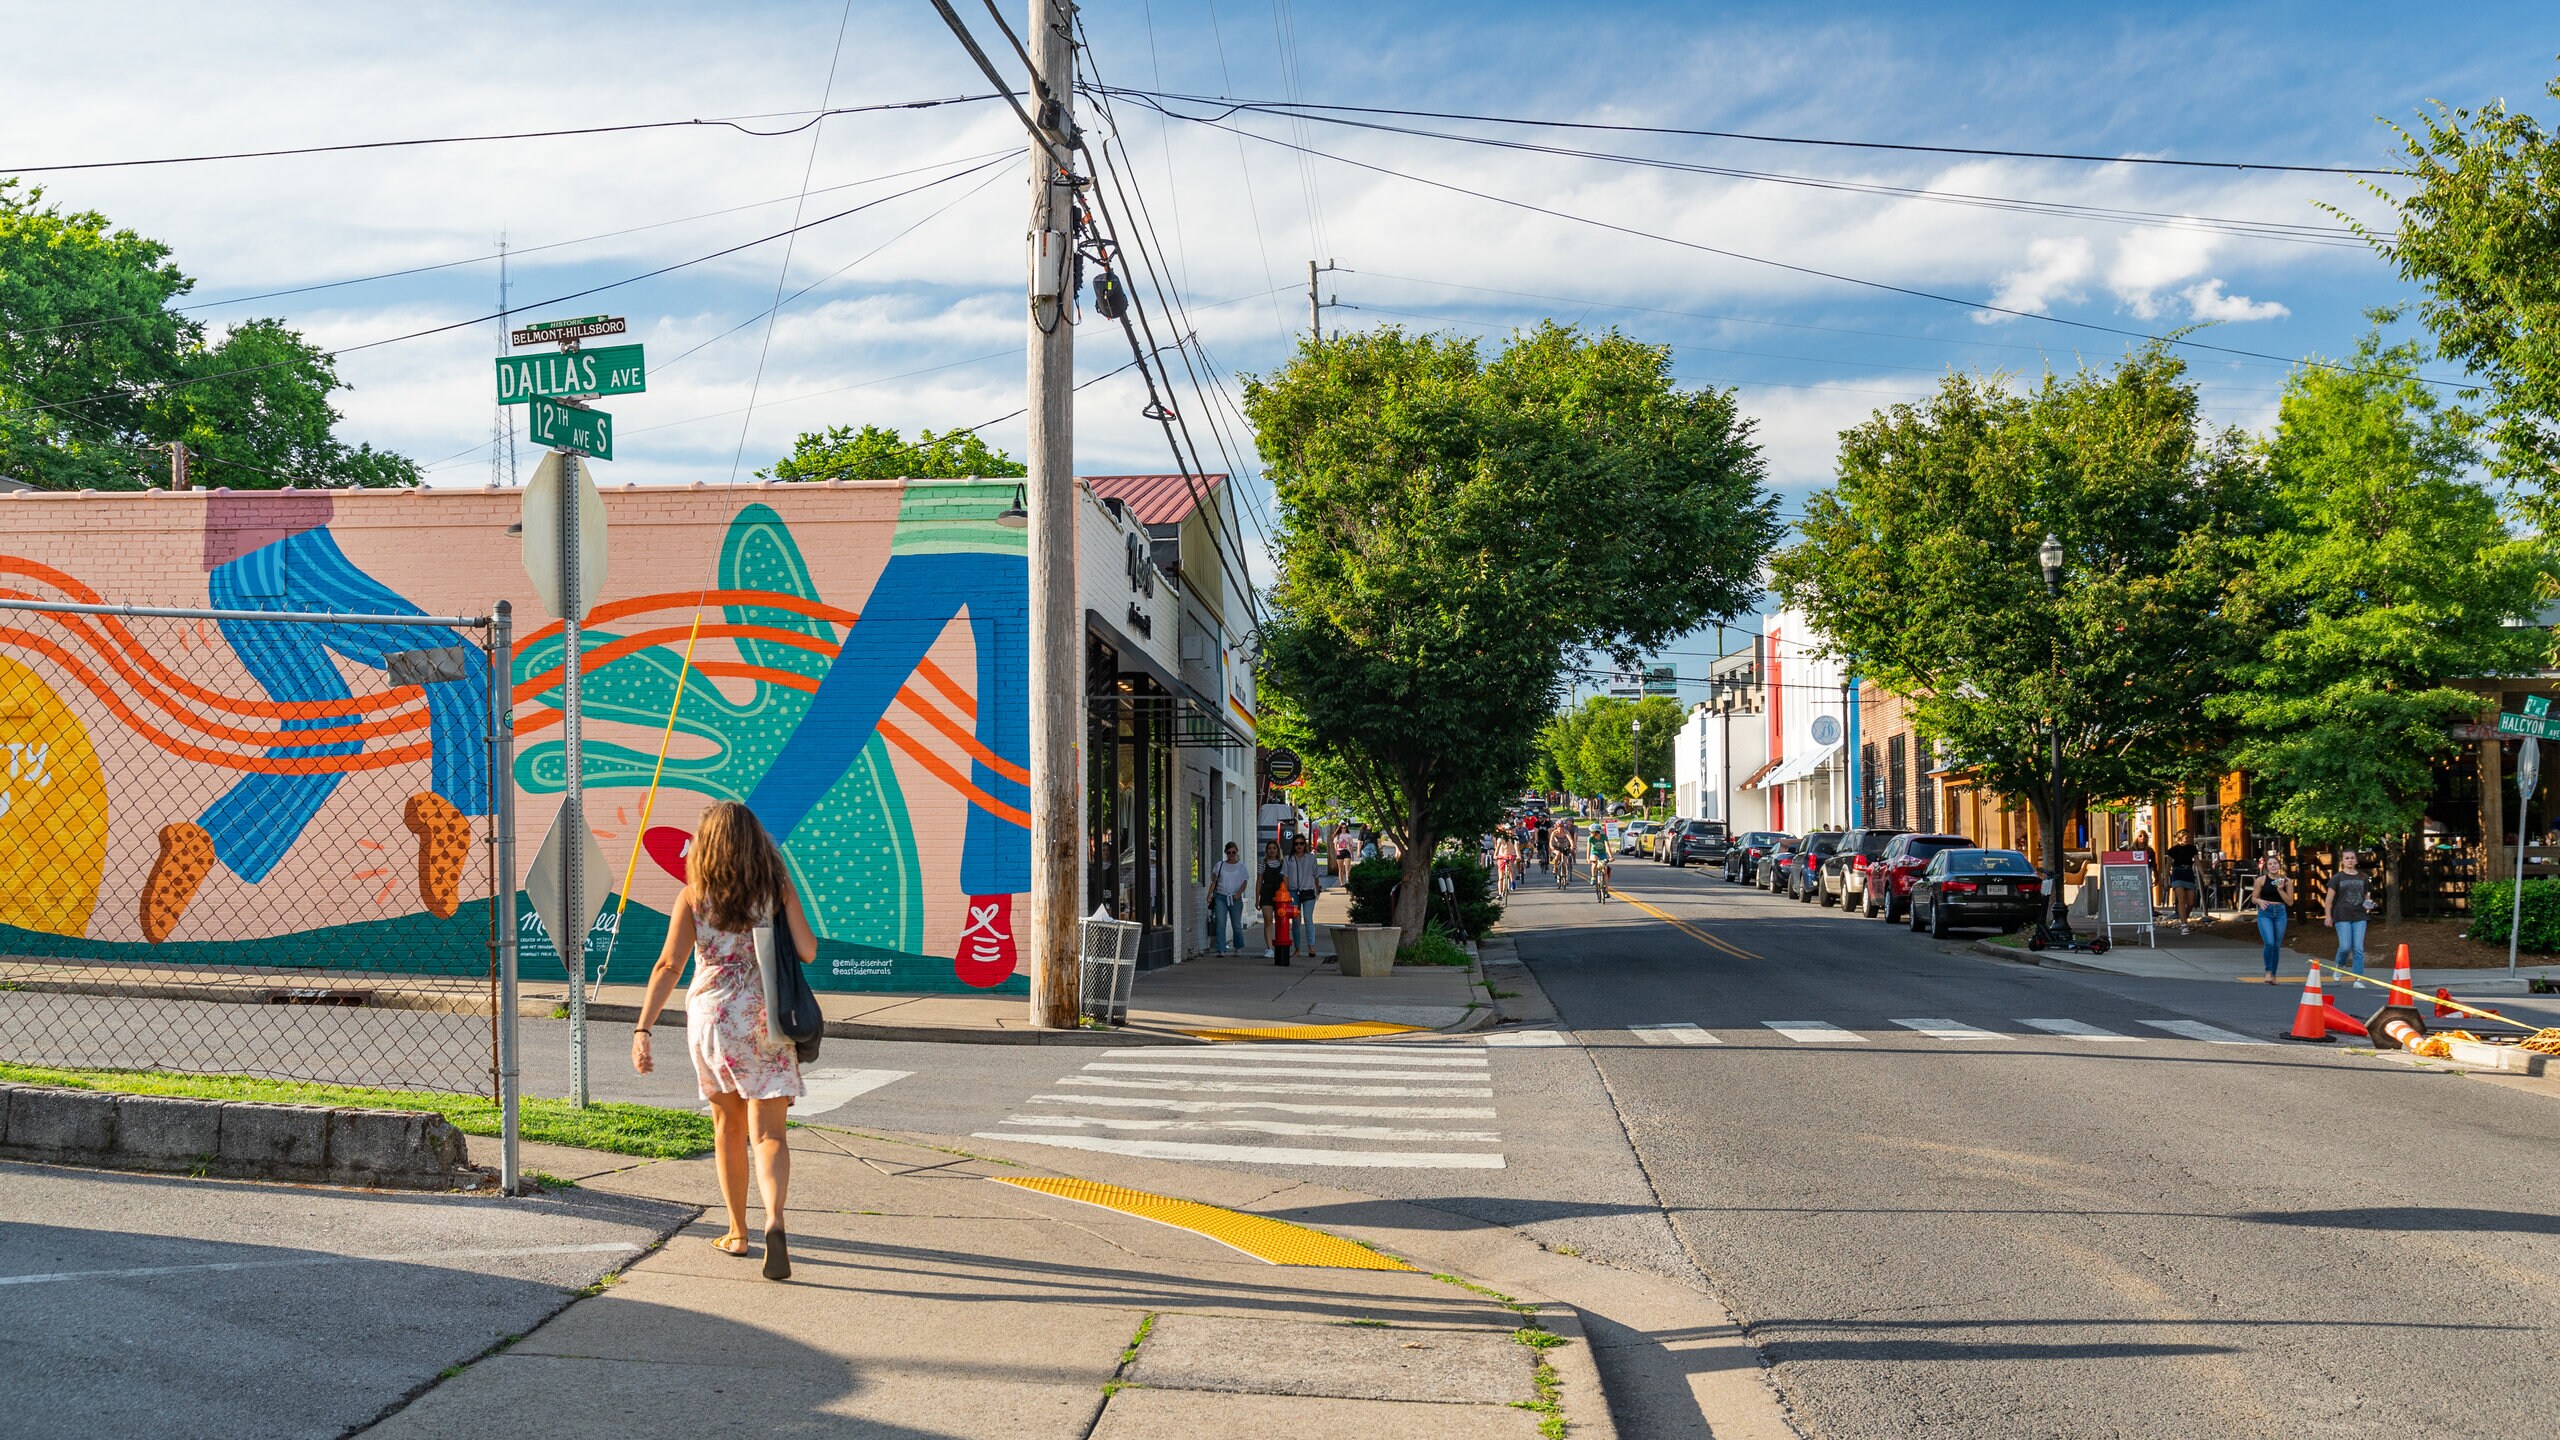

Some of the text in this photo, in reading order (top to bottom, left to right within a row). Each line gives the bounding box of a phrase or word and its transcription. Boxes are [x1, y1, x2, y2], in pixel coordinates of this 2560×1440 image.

[513, 321, 625, 345] BELMONT-HILLSBORO
[550, 319, 585, 328] HISTORIC
[500, 355, 641, 398] DALLAS AVE
[536, 401, 607, 452] 12TH AVE S
[2501, 716, 2560, 738] HALCYON AVE
[832, 968, 891, 976] @eastsidemurals
